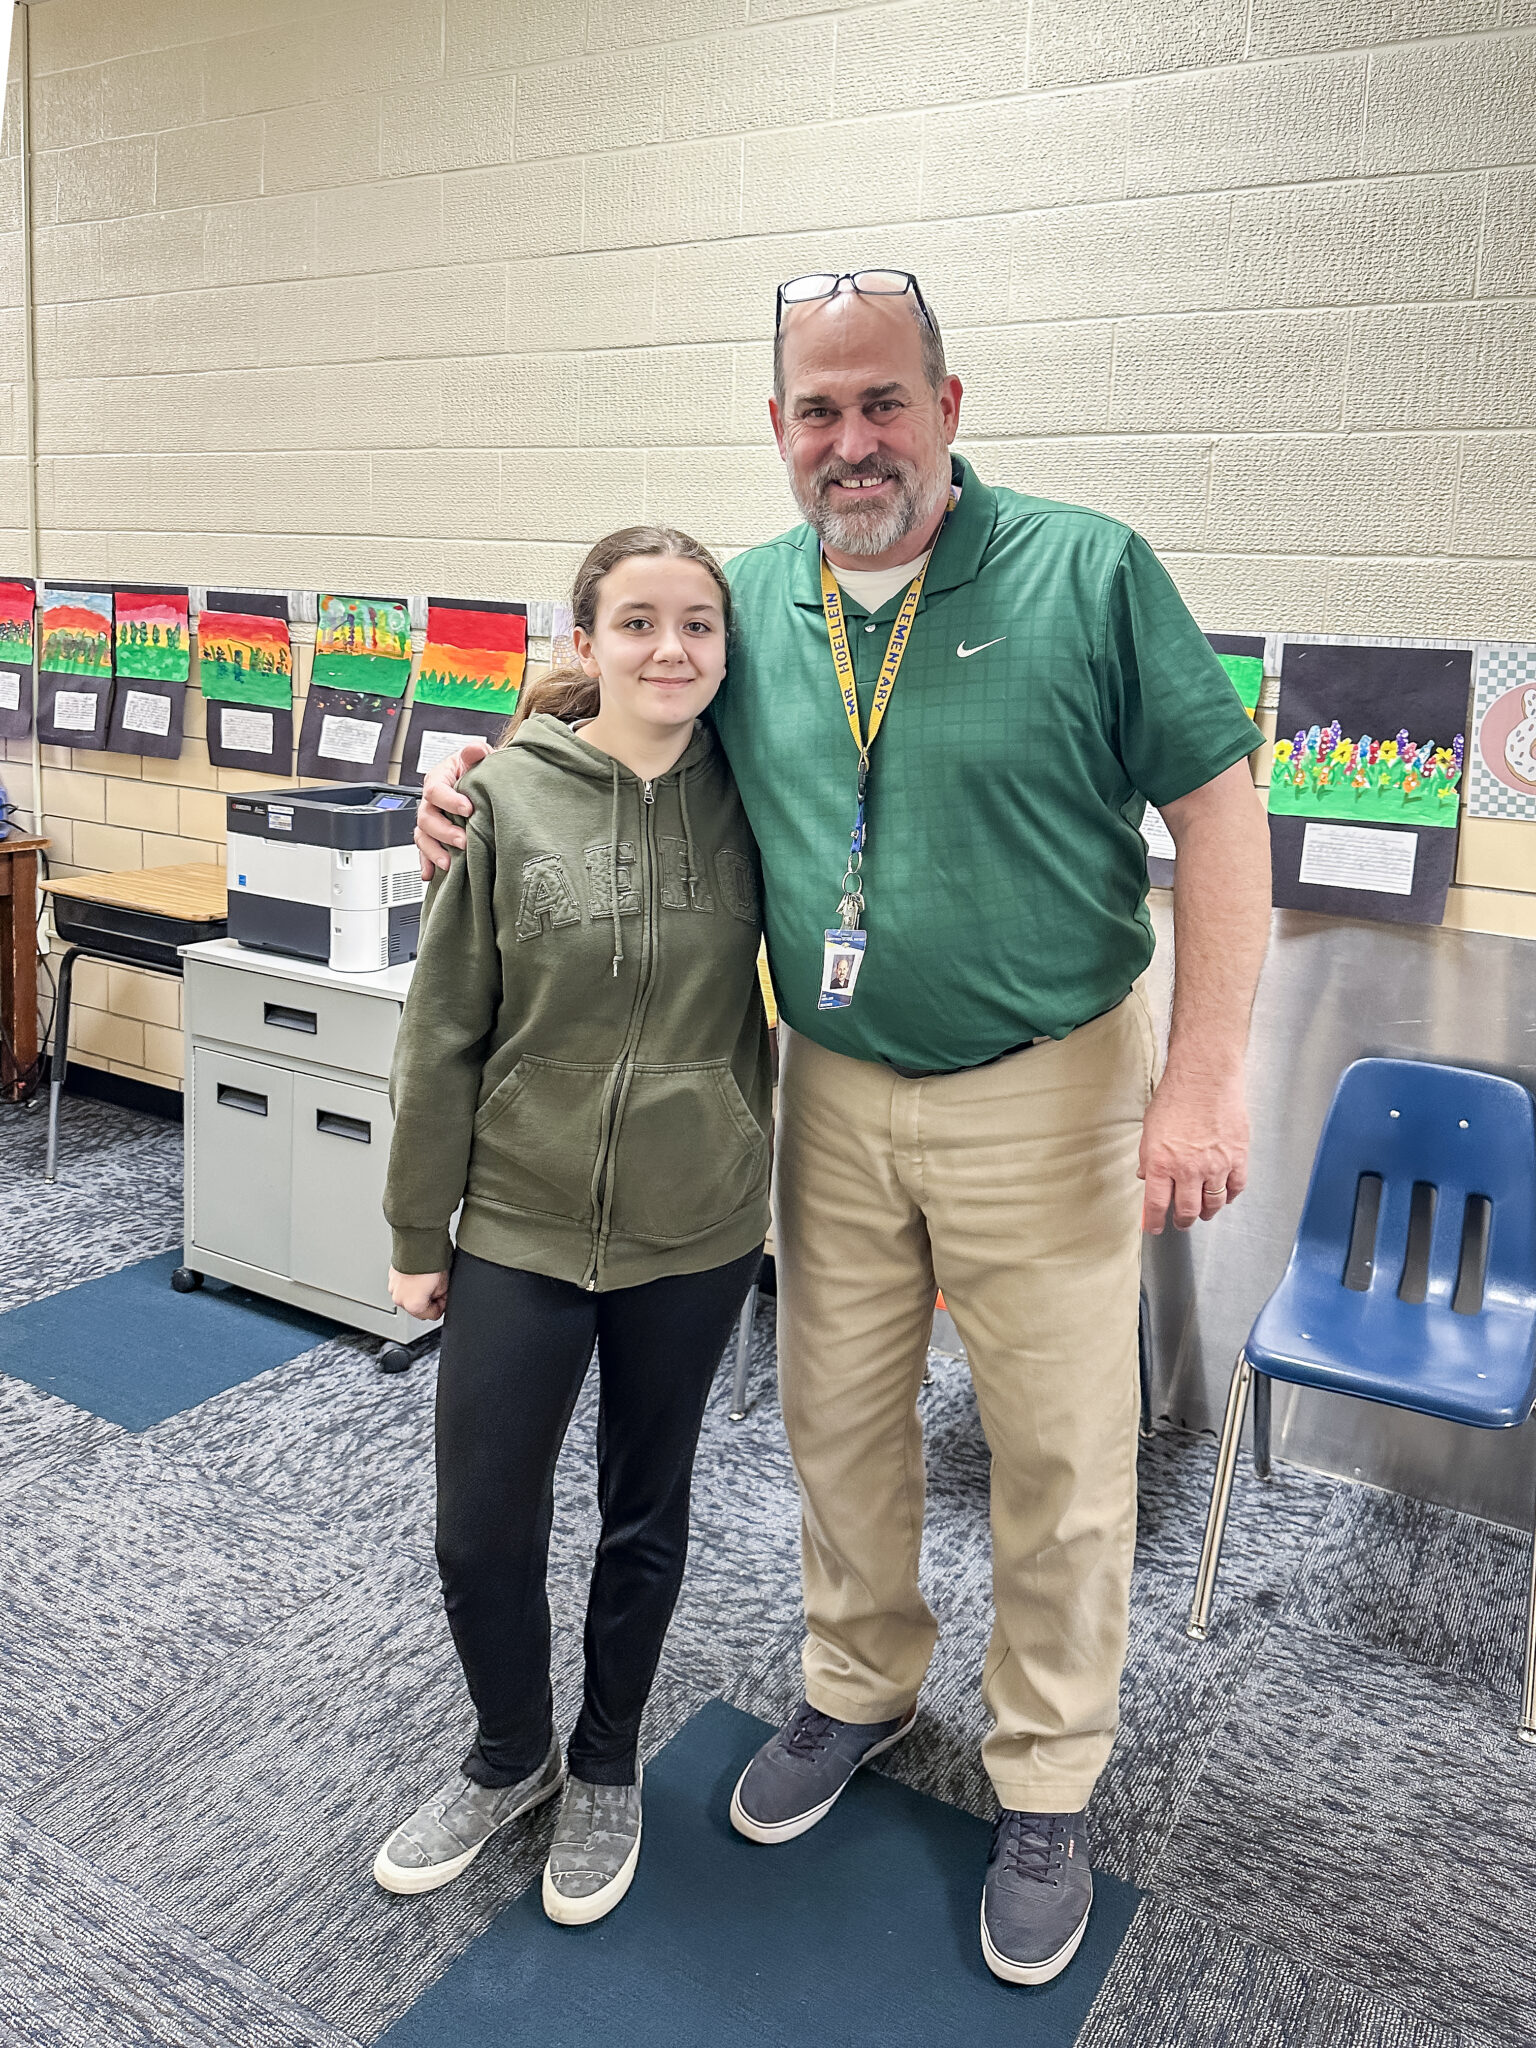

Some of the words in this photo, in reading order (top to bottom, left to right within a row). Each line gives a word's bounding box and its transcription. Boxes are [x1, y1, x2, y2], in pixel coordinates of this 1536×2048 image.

[826, 593, 850, 674] HOELLEIN
[875, 592, 917, 711] ELEMENTARY
[843, 681, 856, 715] MR.
